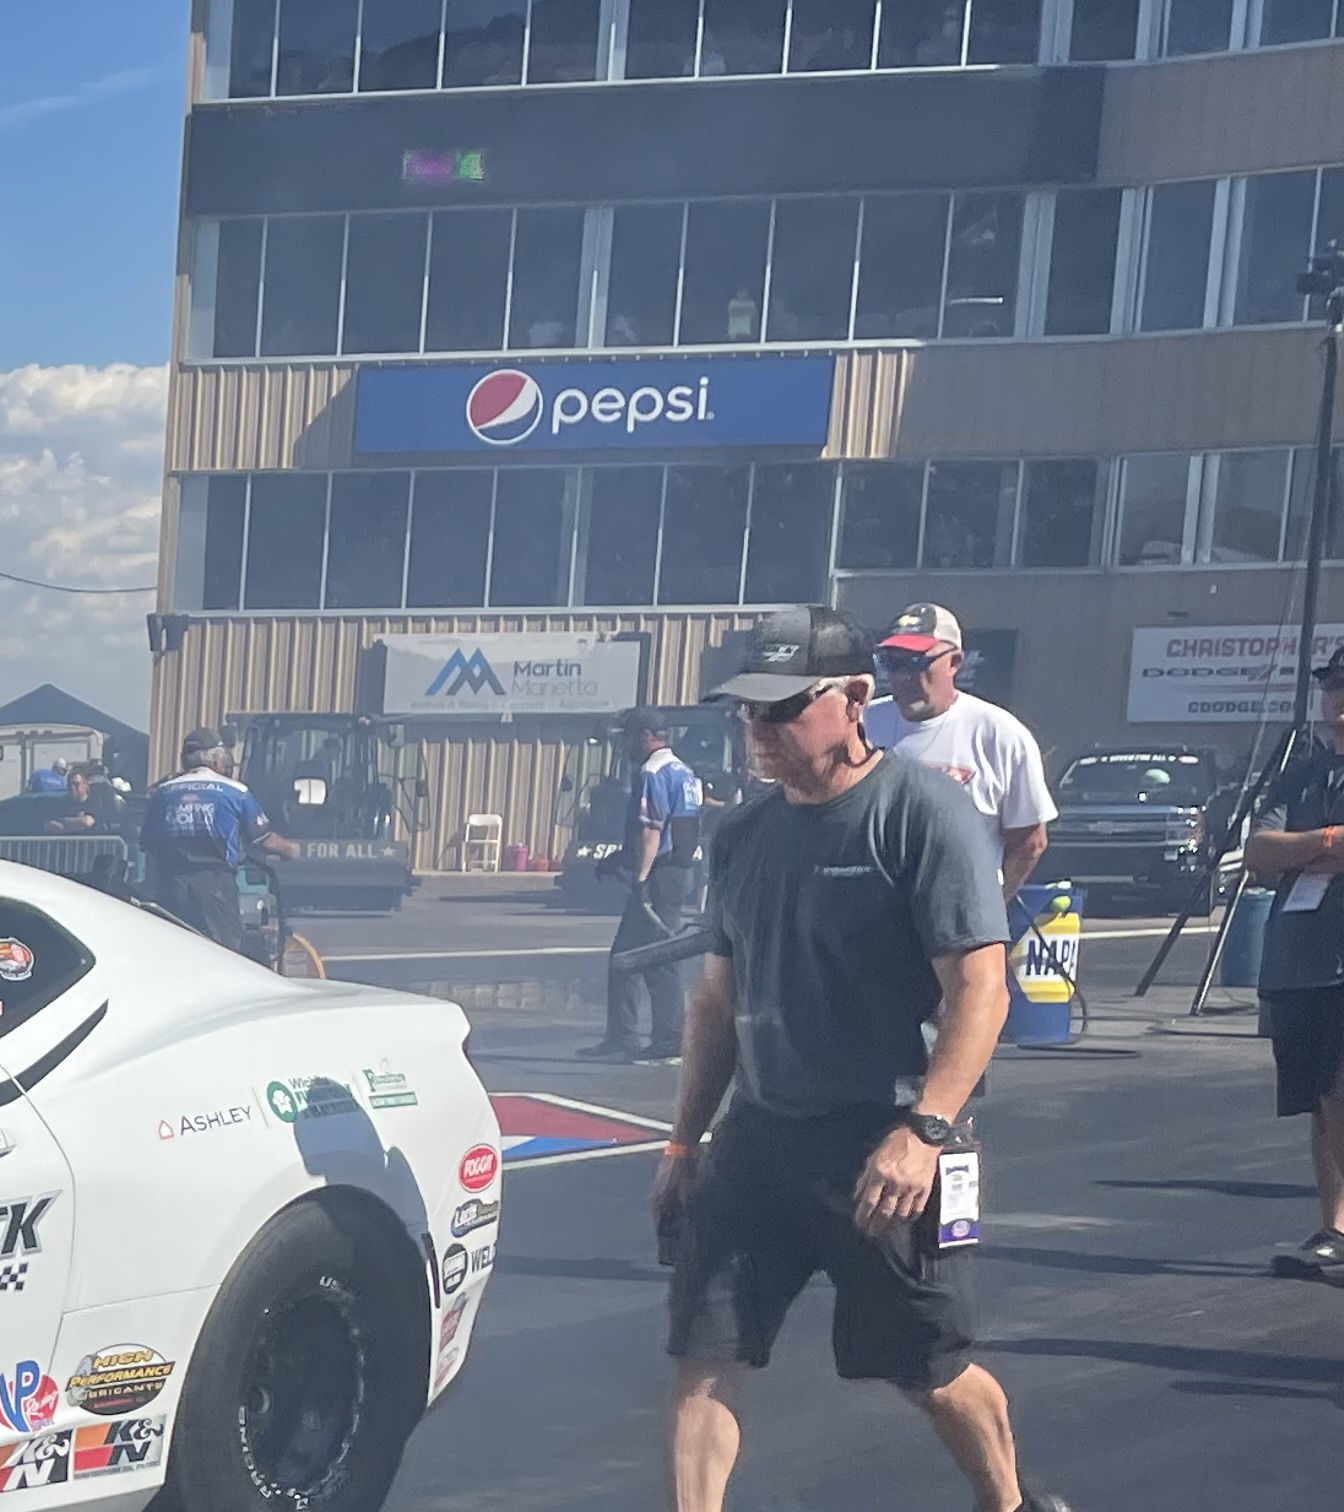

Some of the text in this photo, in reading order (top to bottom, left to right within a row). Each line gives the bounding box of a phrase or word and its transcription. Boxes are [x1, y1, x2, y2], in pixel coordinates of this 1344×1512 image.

[552, 376, 709, 434] pepsi
[1167, 634, 1344, 658] CHRISTOPHR'
[513, 659, 583, 677] Martin
[511, 678, 599, 697] Marietta
[307, 842, 339, 858] FOR
[346, 843, 379, 858] ALL
[180, 1104, 251, 1137] ASHLEY
[470, 1246, 496, 1273] WEL
[93, 1350, 154, 1369] HIGH
[68, 1362, 175, 1388] PERFORMANCE
[103, 1417, 165, 1467] K&N
[3, 1433, 70, 1491] K&N
